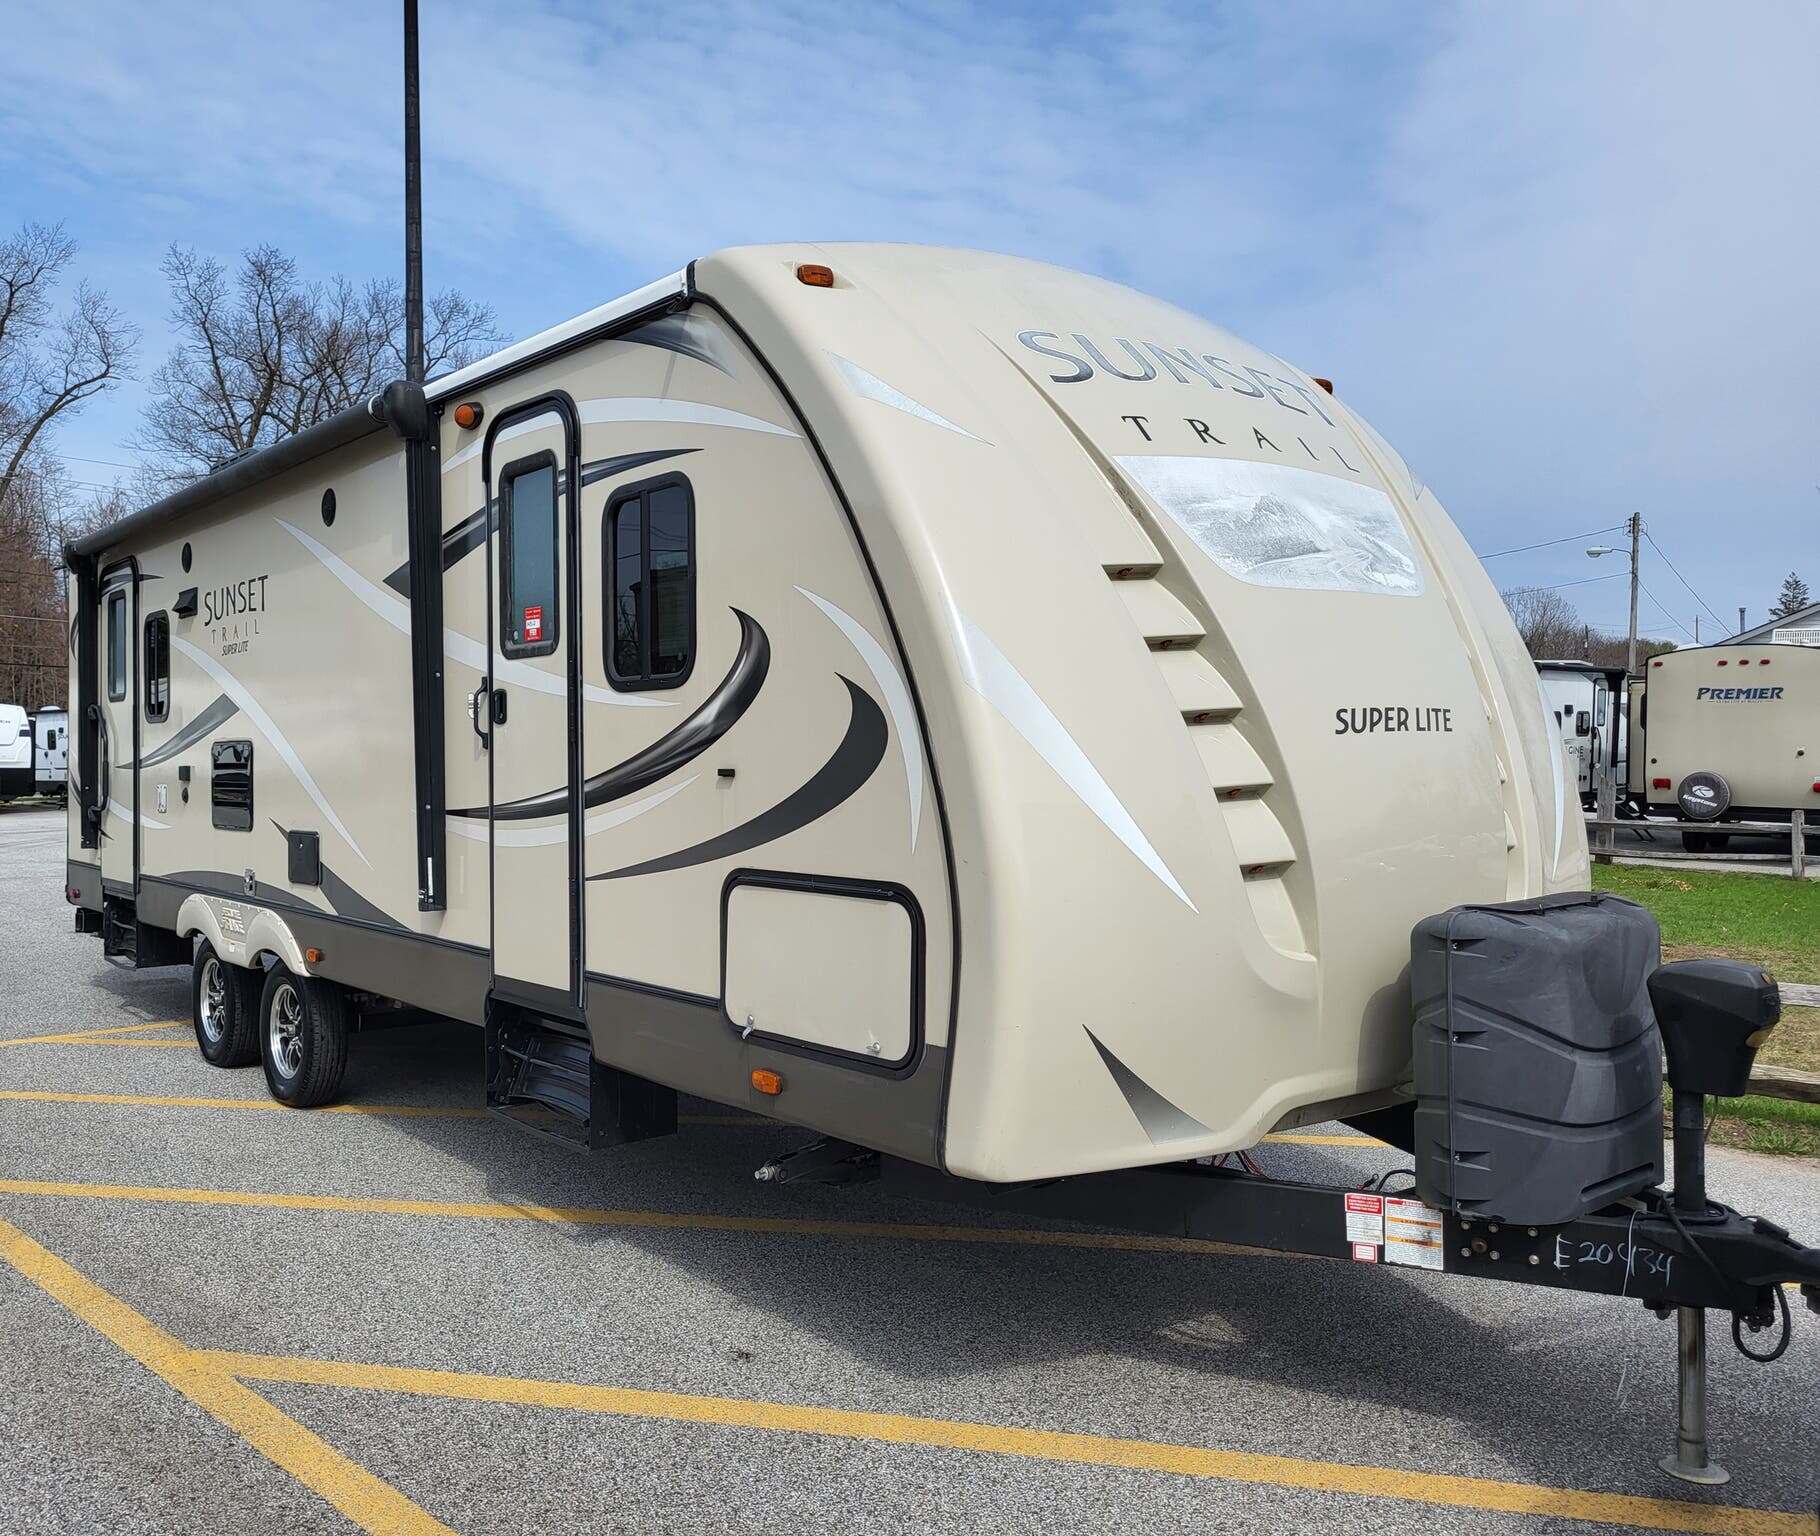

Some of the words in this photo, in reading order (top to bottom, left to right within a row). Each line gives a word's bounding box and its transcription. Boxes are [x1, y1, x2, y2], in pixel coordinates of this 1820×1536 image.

[1016, 329, 1337, 428] SUNSET
[1121, 415, 1361, 473] TRAIL
[204, 575, 268, 627] SUNSET
[211, 619, 260, 645] TRAIL
[1696, 687, 1784, 700] PREMIER
[1335, 707, 1409, 735] SUPER
[1416, 707, 1453, 732] LITE
